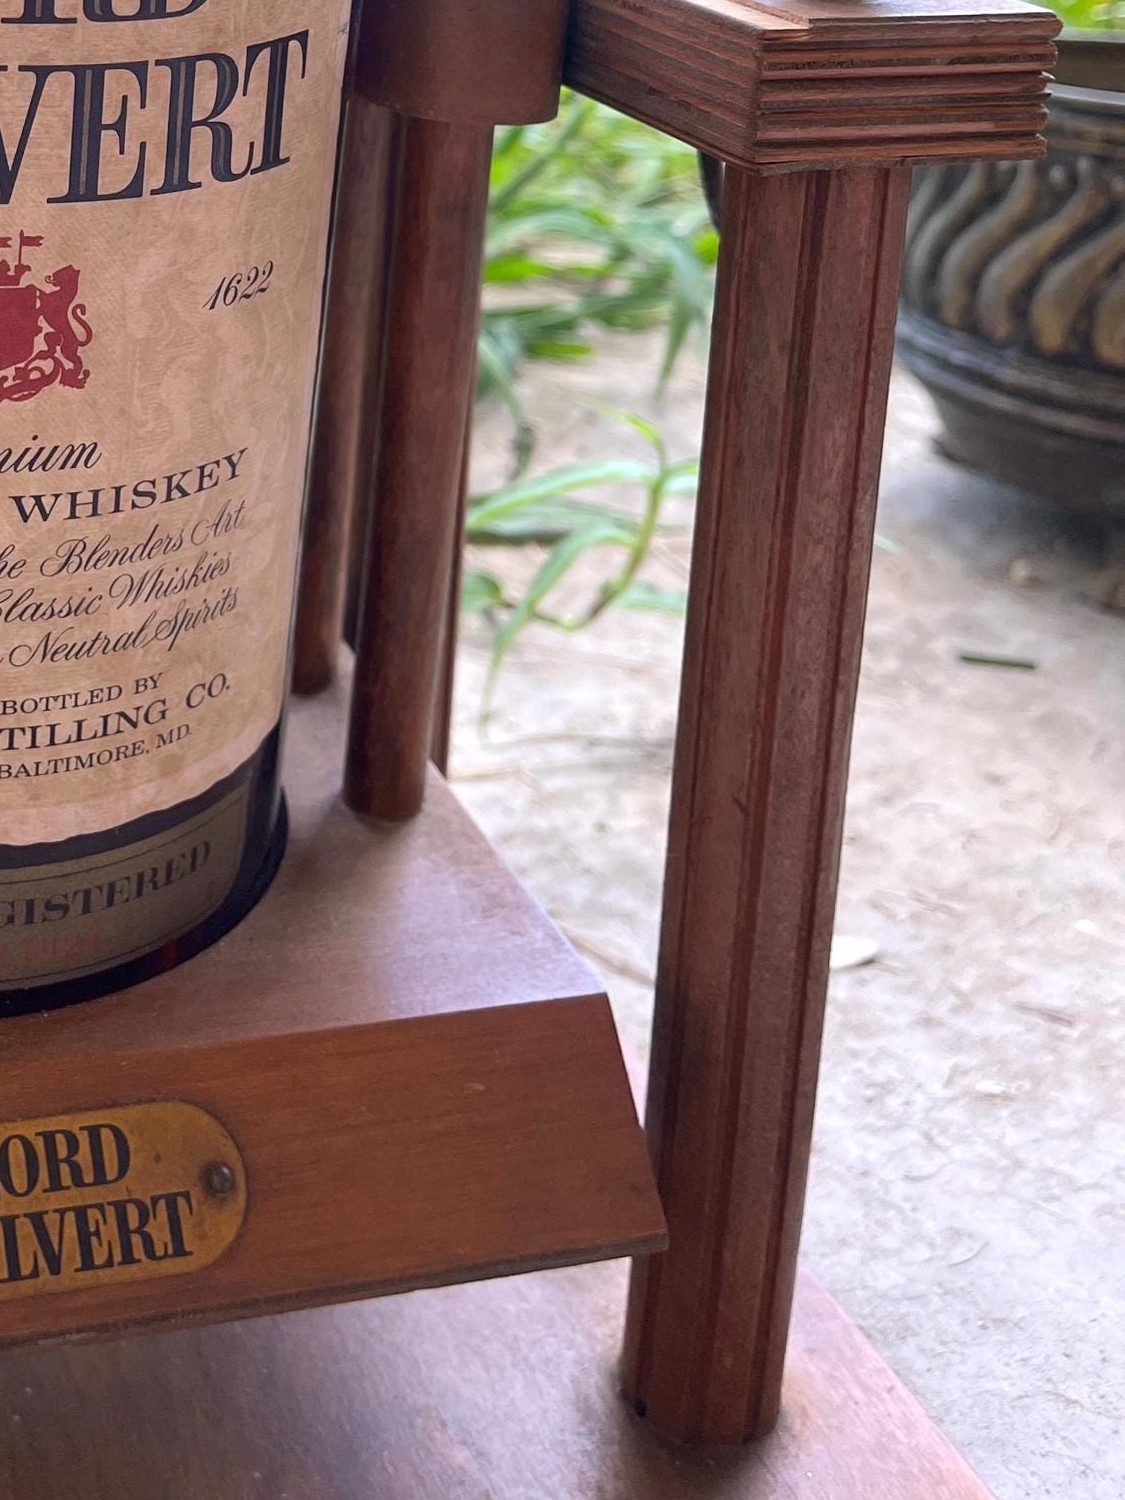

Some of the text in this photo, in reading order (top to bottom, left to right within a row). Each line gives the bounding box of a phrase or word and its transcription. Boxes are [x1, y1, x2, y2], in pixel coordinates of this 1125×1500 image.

[203, 260, 274, 312] 1622
[8, 446, 249, 525] WHISKEY
[39, 524, 184, 578] Blenders
[190, 499, 246, 546] Art
[109, 550, 232, 610] Whiskies
[8, 610, 157, 668] Neutral
[155, 585, 240, 652] Spirits
[0, 683, 123, 716] BOTTLED
[133, 672, 163, 695] BY
[185, 672, 232, 709] CO.
